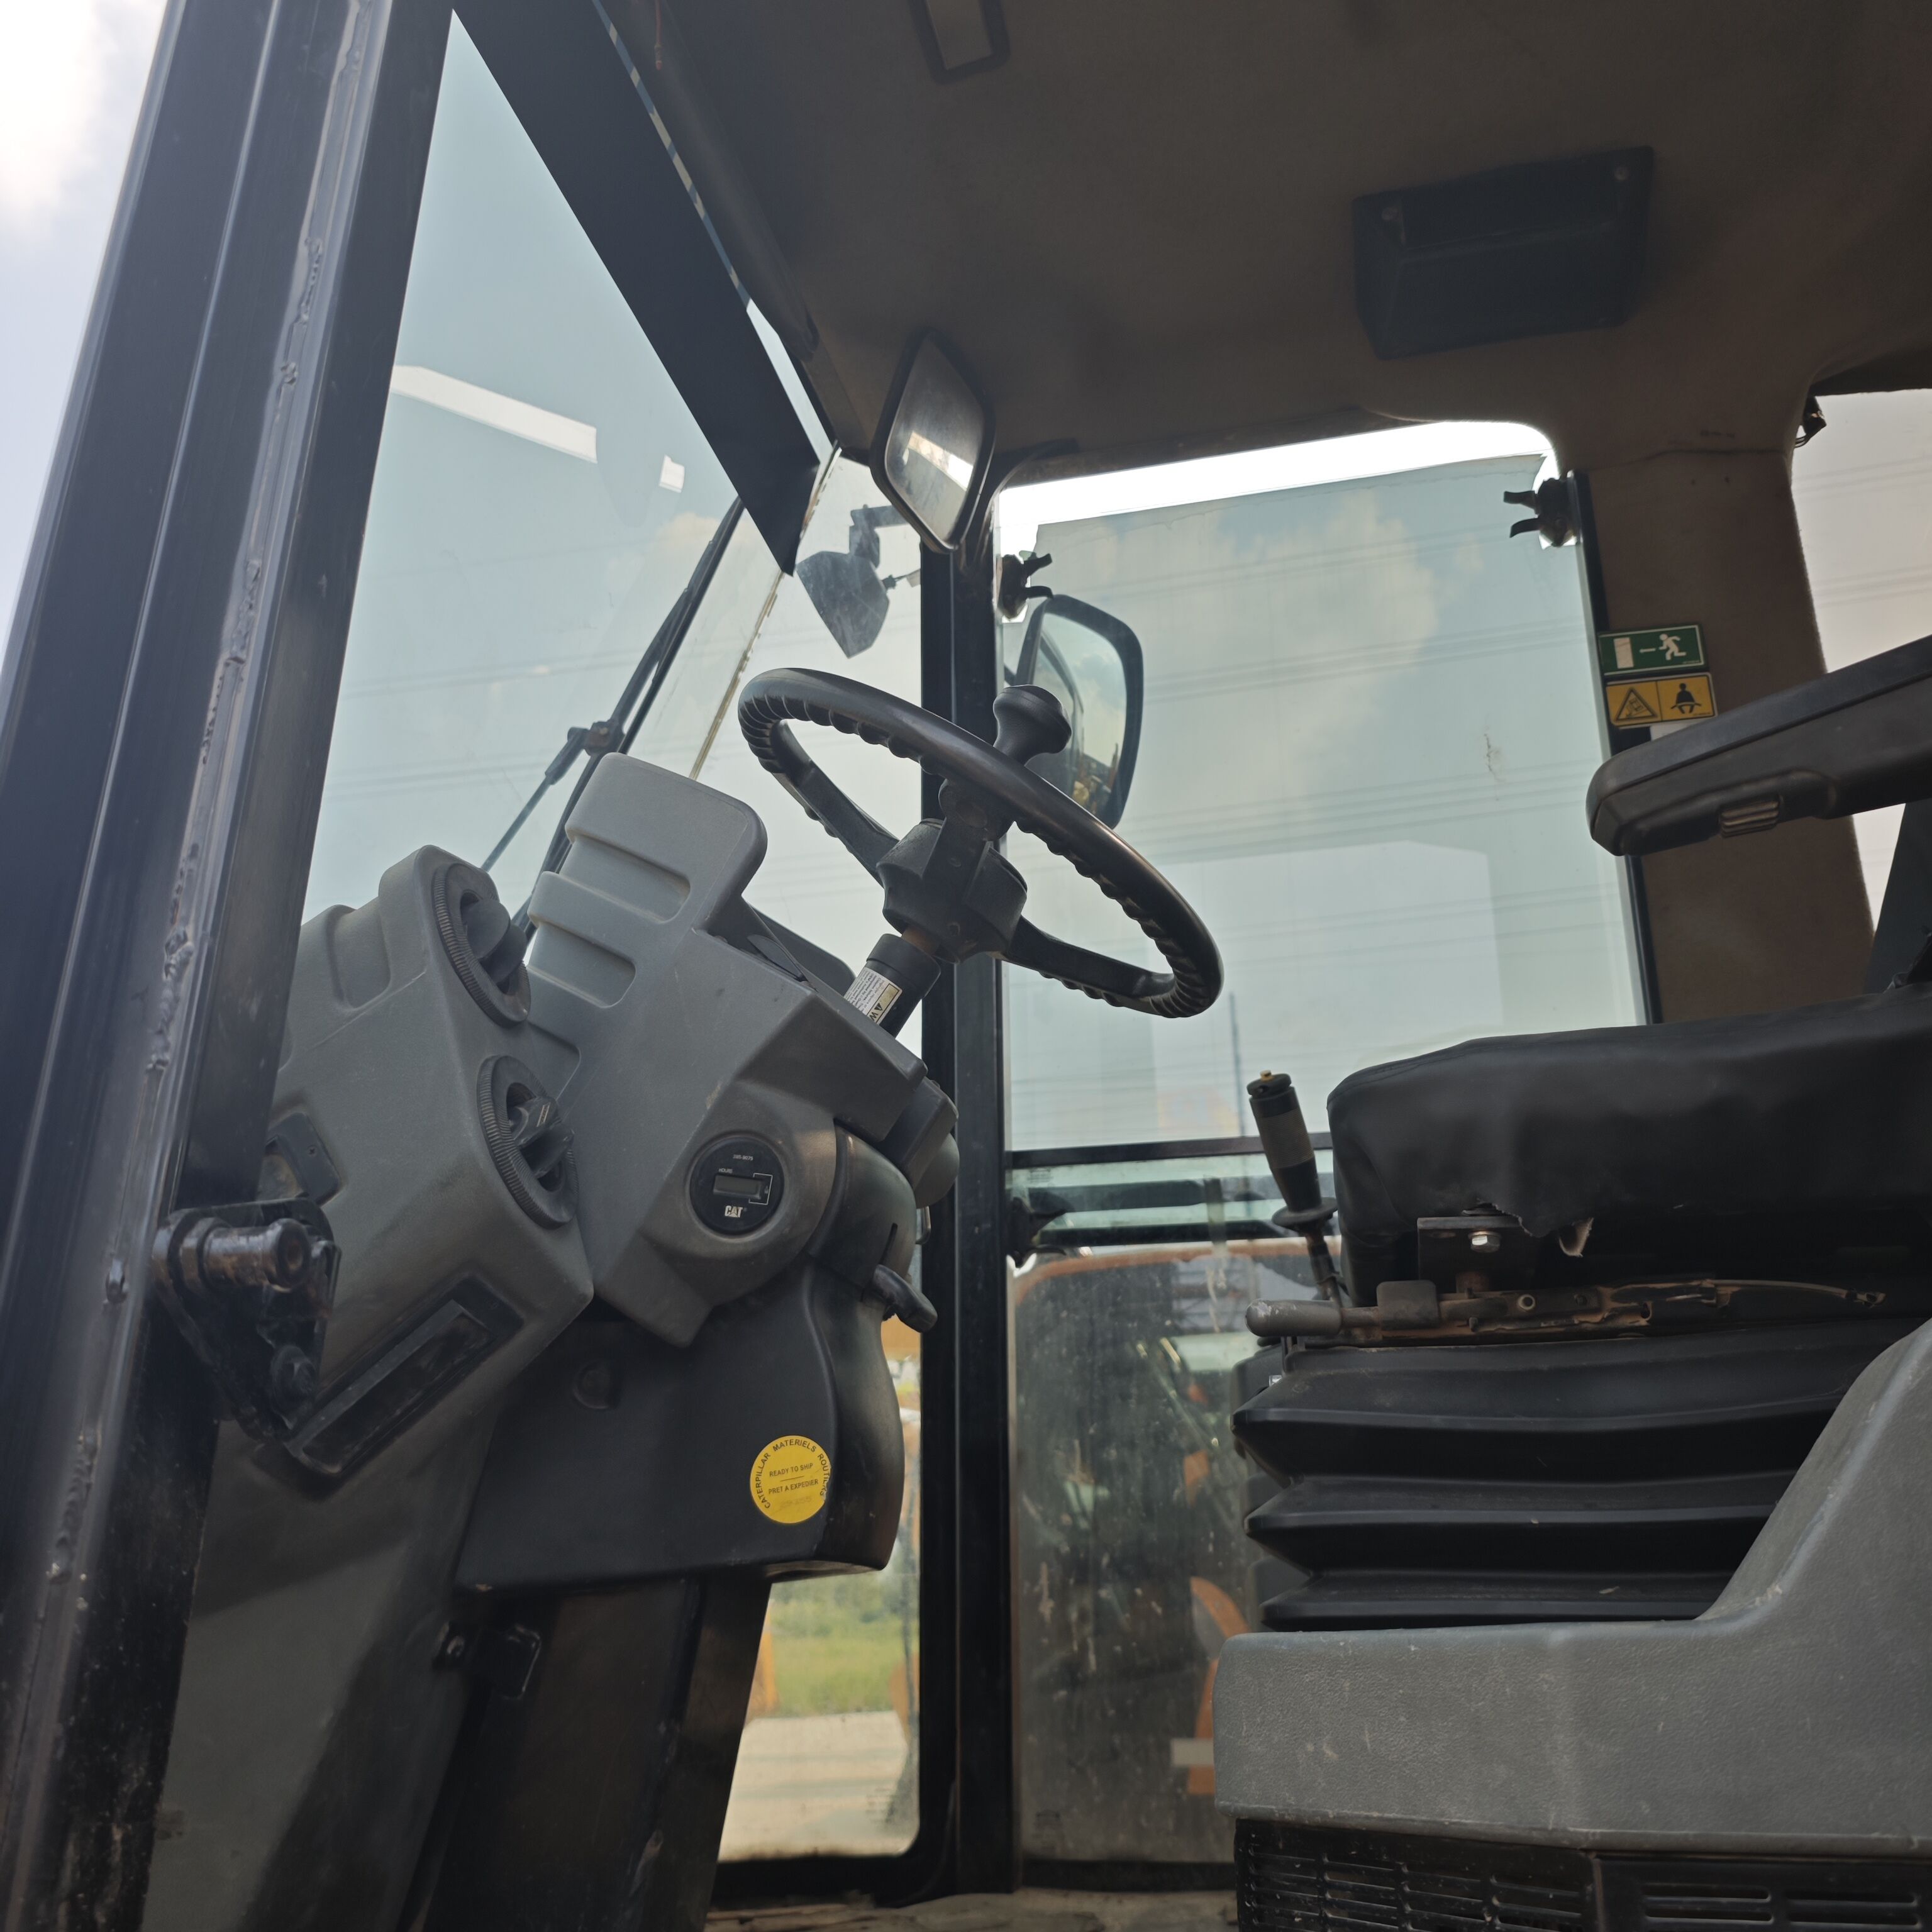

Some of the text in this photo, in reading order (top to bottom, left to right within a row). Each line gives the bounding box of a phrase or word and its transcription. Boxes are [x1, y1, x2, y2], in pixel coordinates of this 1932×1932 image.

[724, 1205, 743, 1218] CAT
[755, 1453, 771, 1509] CATERPILLAR
[772, 1439, 817, 1452] MATERIELS
[769, 1468, 789, 1477] READY
[769, 1486, 783, 1494] PRET
[791, 1479, 819, 1491] EXPEDIER
